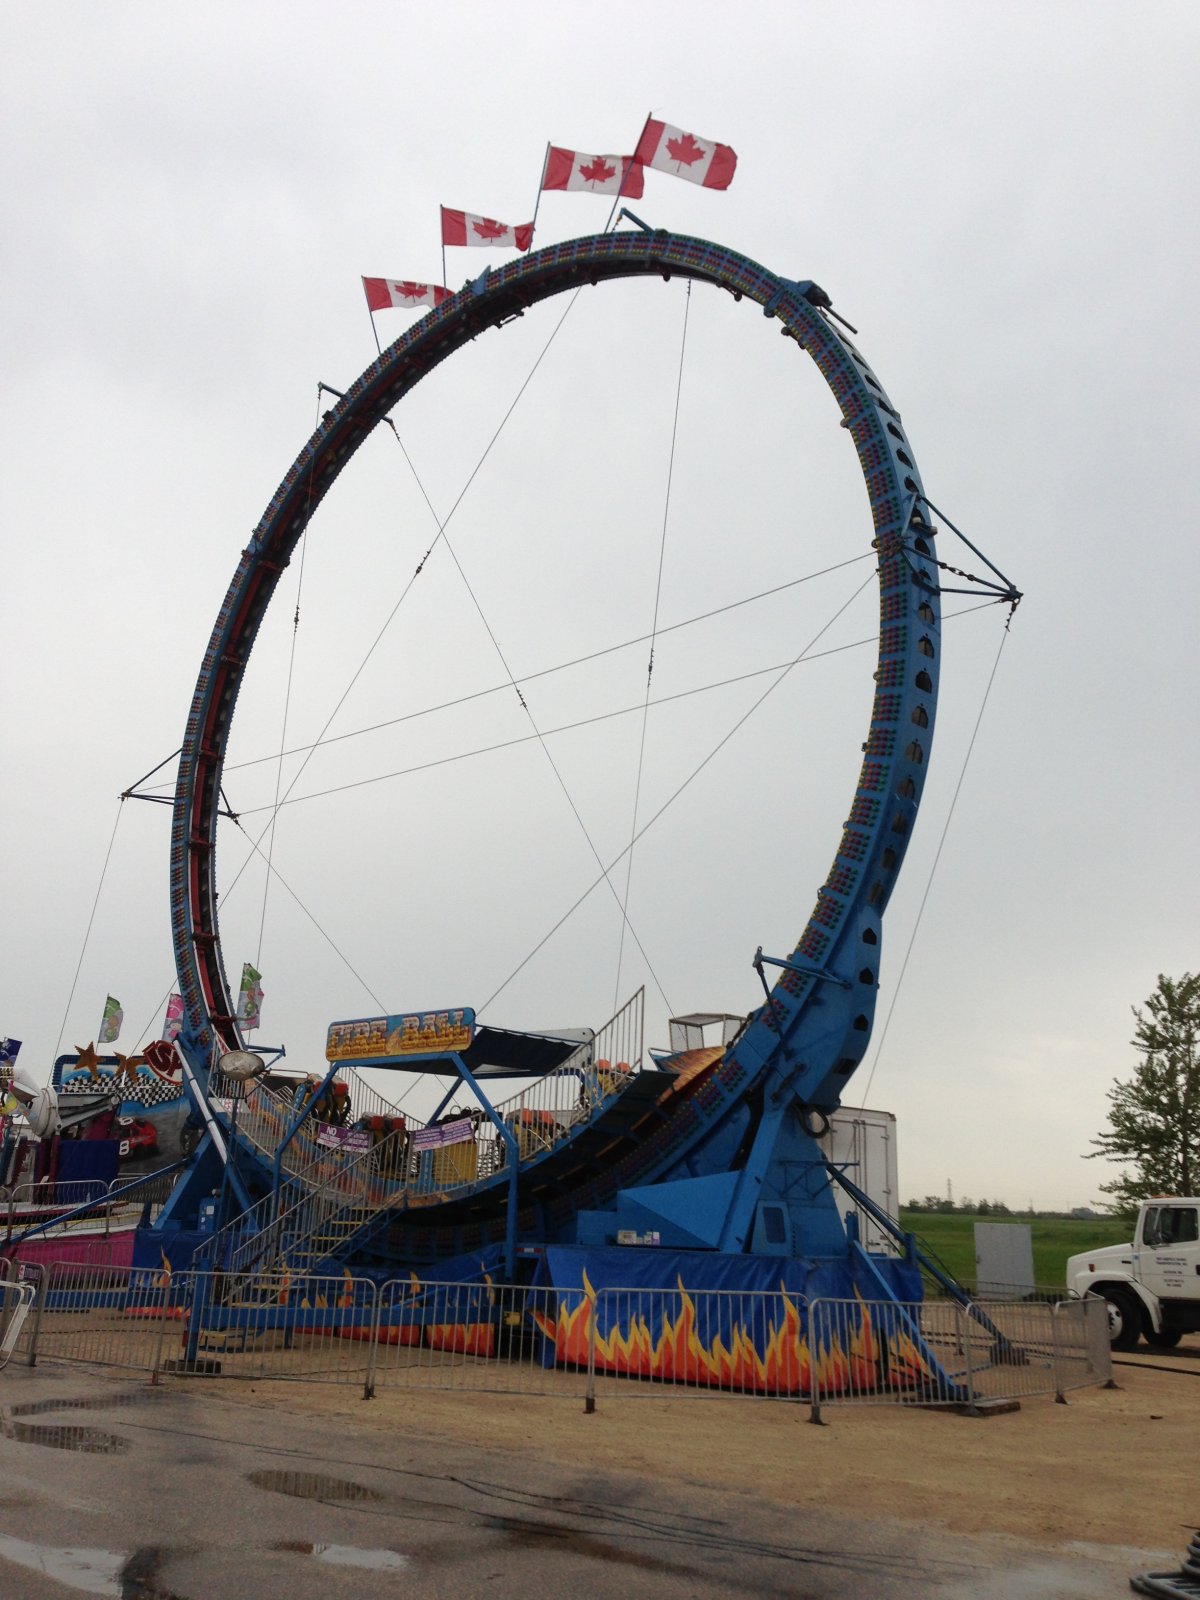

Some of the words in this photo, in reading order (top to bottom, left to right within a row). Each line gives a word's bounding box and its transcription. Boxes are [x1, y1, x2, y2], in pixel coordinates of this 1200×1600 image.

[327, 1020, 387, 1056] FIRE
[400, 1010, 469, 1050] BALL
[326, 1126, 337, 1136] NO
[119, 1140, 129, 1156] 8
